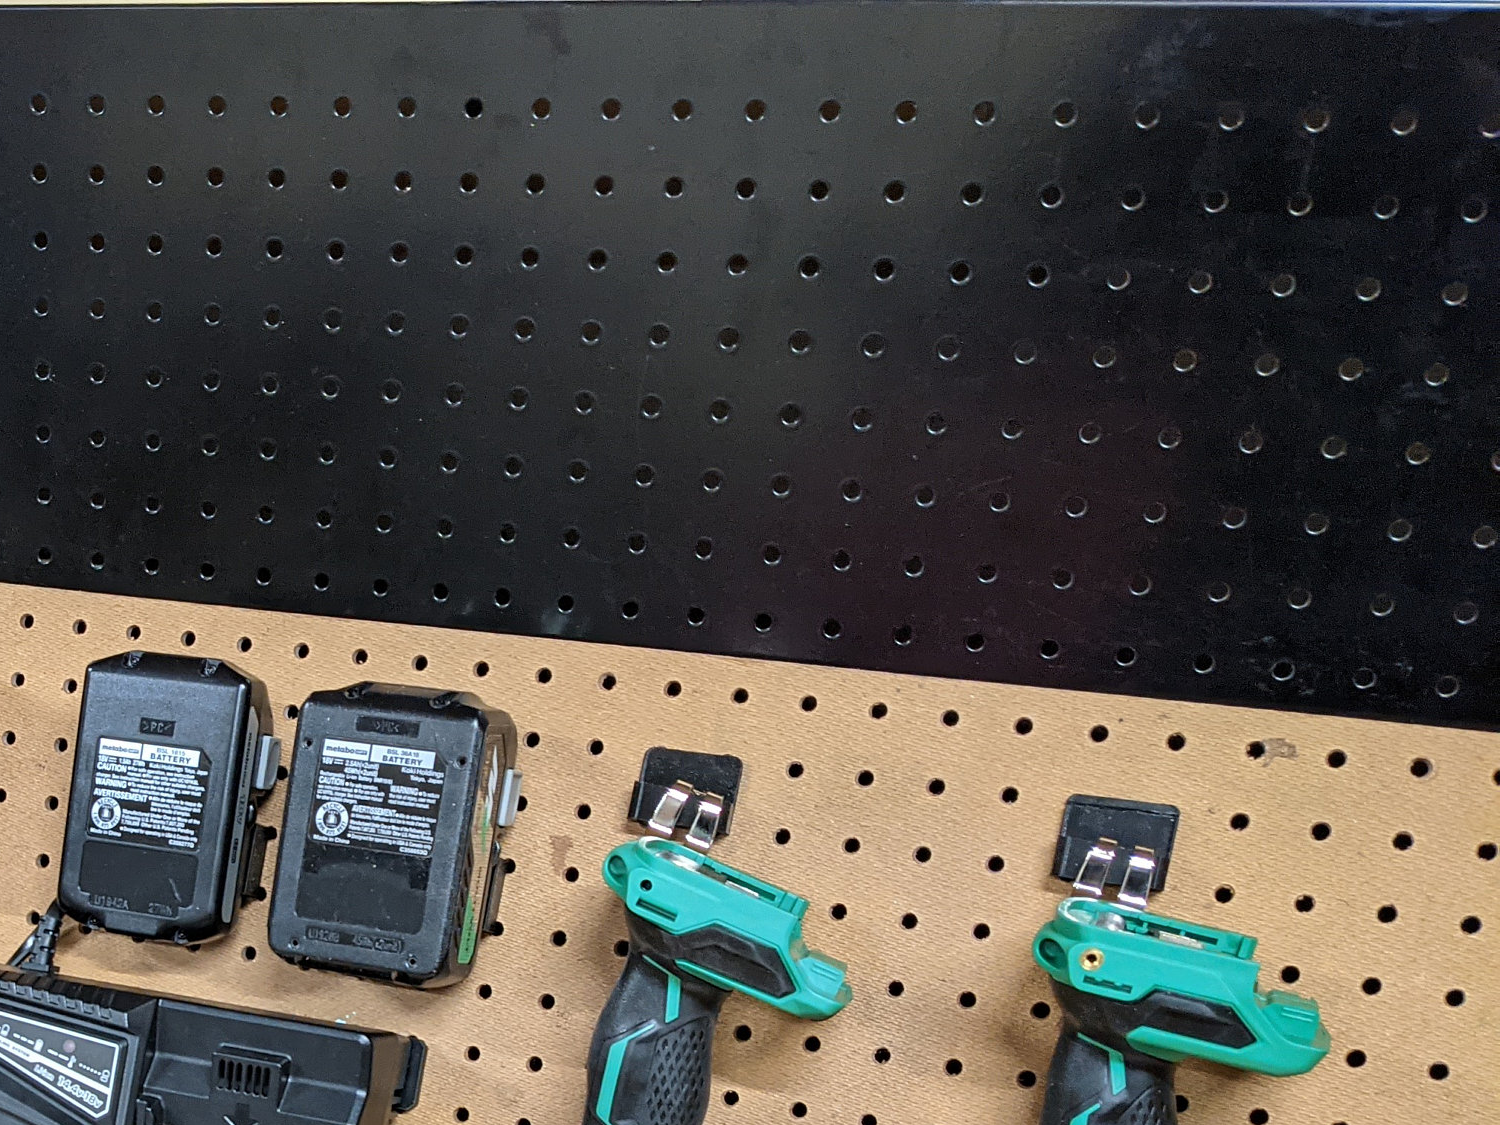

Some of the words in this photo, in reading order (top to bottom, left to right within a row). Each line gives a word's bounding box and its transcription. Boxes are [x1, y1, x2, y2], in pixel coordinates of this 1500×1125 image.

[325, 744, 354, 754] metabo
[150, 753, 191, 764] BATTERY
[382, 755, 424, 766] BATTERY
[97, 762, 127, 773] CAUTION
[95, 777, 127, 788] WARNING
